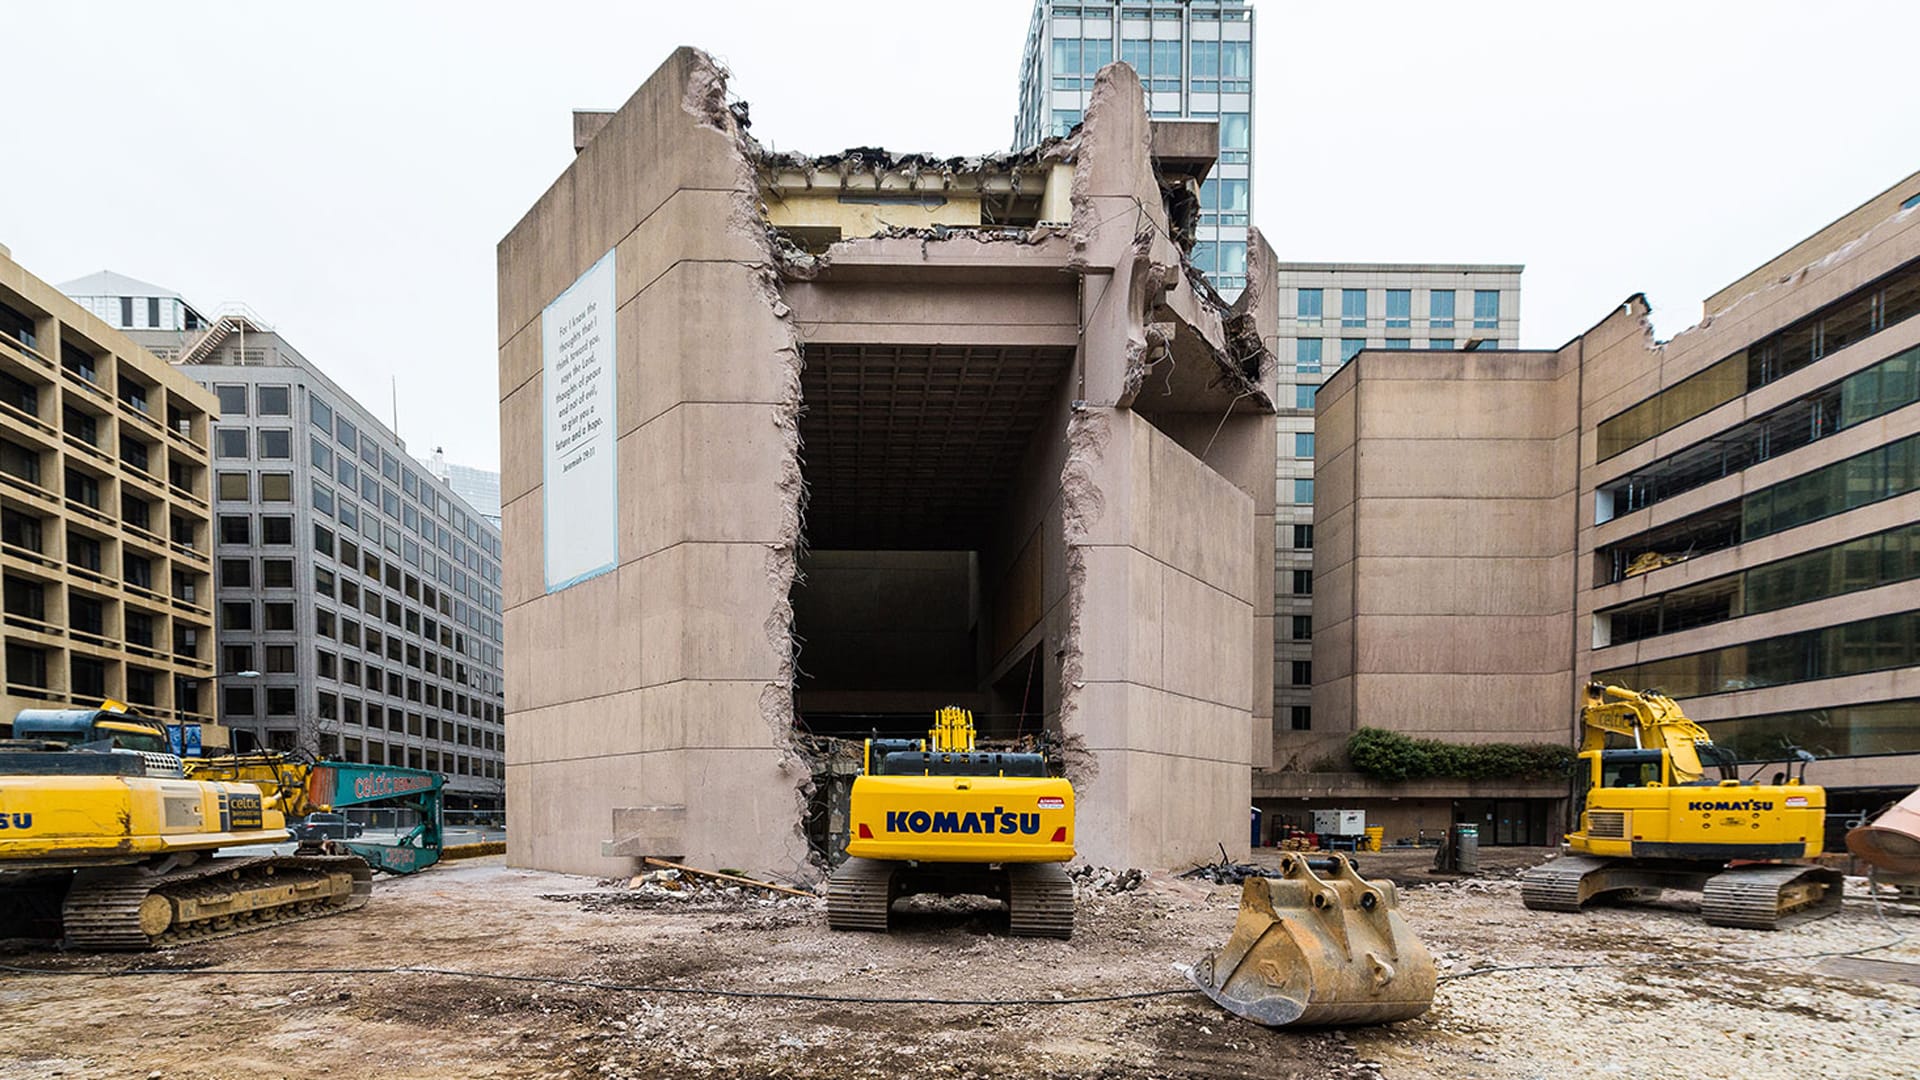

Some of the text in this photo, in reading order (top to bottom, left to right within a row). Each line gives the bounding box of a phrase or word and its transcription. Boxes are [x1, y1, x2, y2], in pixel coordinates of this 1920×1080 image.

[559, 326, 567, 337] For
[572, 310, 585, 327] know
[587, 302, 597, 314] the
[559, 331, 581, 353] thoughts
[582, 319, 593, 336] that
[556, 354, 569, 371] think
[570, 338, 588, 361] toward
[556, 383, 578, 404] thoughts
[585, 367, 601, 386] peace
[561, 371, 571, 384] says
[559, 402, 569, 418] and
[570, 397, 578, 411] not
[568, 415, 578, 431] give
[579, 410, 589, 423] you
[555, 437, 570, 451] future
[572, 425, 581, 442] and
[587, 417, 603, 431] hope.
[562, 446, 595, 473] Jeremiah 29:11
[1688, 798, 1774, 812] KOMATSU
[886, 806, 1041, 835] KOMATSU
